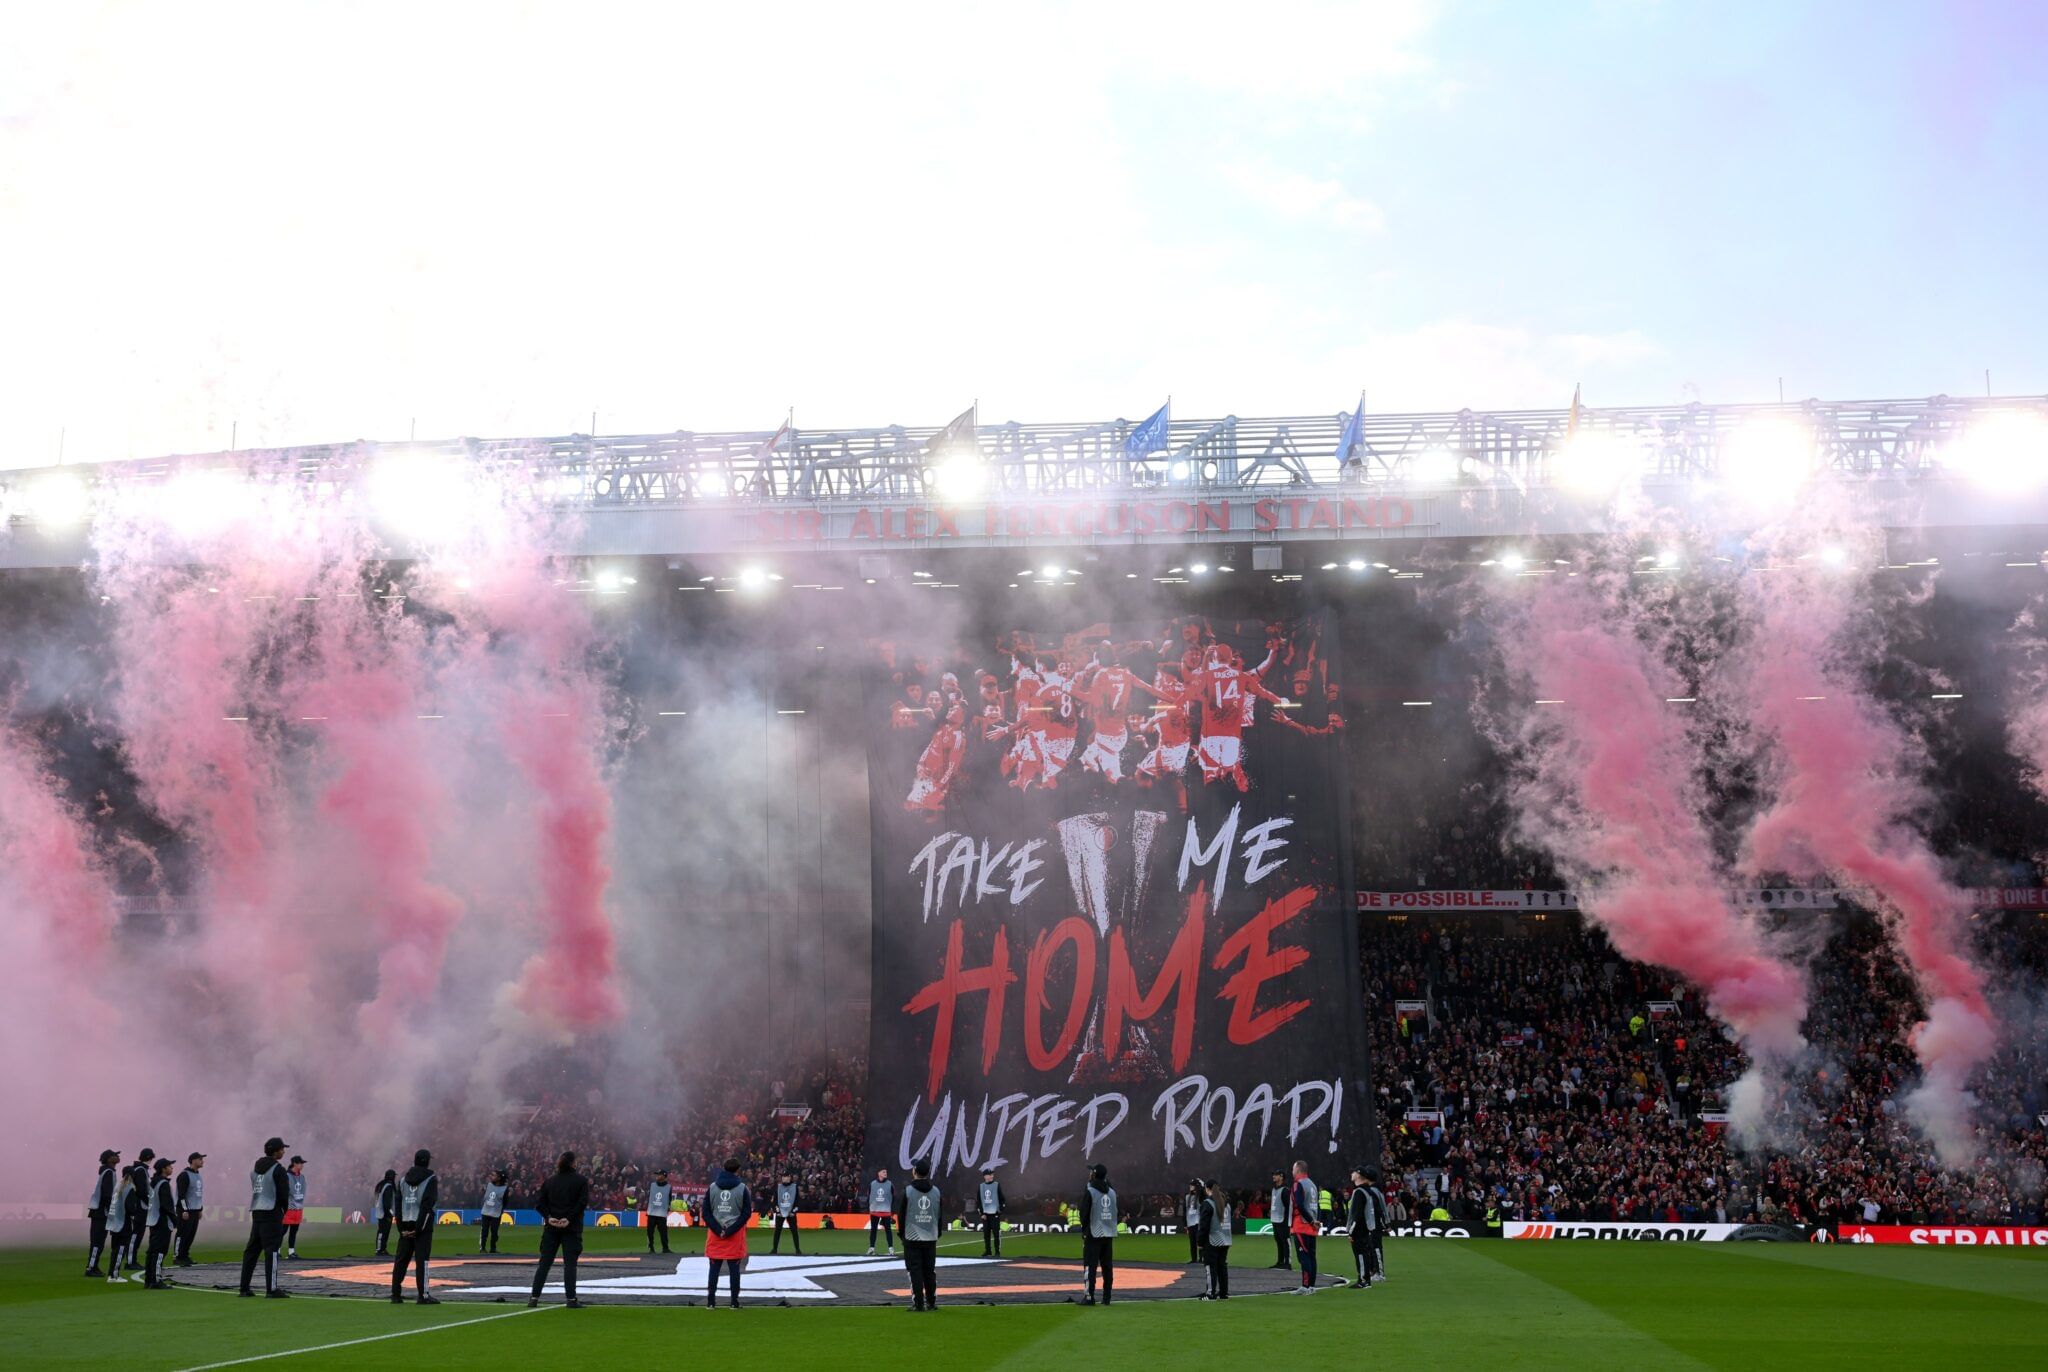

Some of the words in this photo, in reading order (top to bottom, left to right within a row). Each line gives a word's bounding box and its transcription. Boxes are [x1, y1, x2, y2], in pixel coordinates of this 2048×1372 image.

[752, 508, 824, 541] SIR
[850, 505, 961, 539] ALEX
[985, 500, 1231, 537] FERGUSON
[1253, 495, 1415, 532] STAND
[1060, 693, 1073, 718] 8
[1111, 682, 1125, 711] 7
[1214, 679, 1242, 709] 14
[908, 830, 1048, 924] TAKE
[1177, 801, 1295, 916] ME
[2003, 889, 2038, 905] ONE
[901, 880, 1319, 1106] HOME
[899, 1092, 1129, 1181] UNITED
[1152, 1074, 1344, 1163] ROAD!
